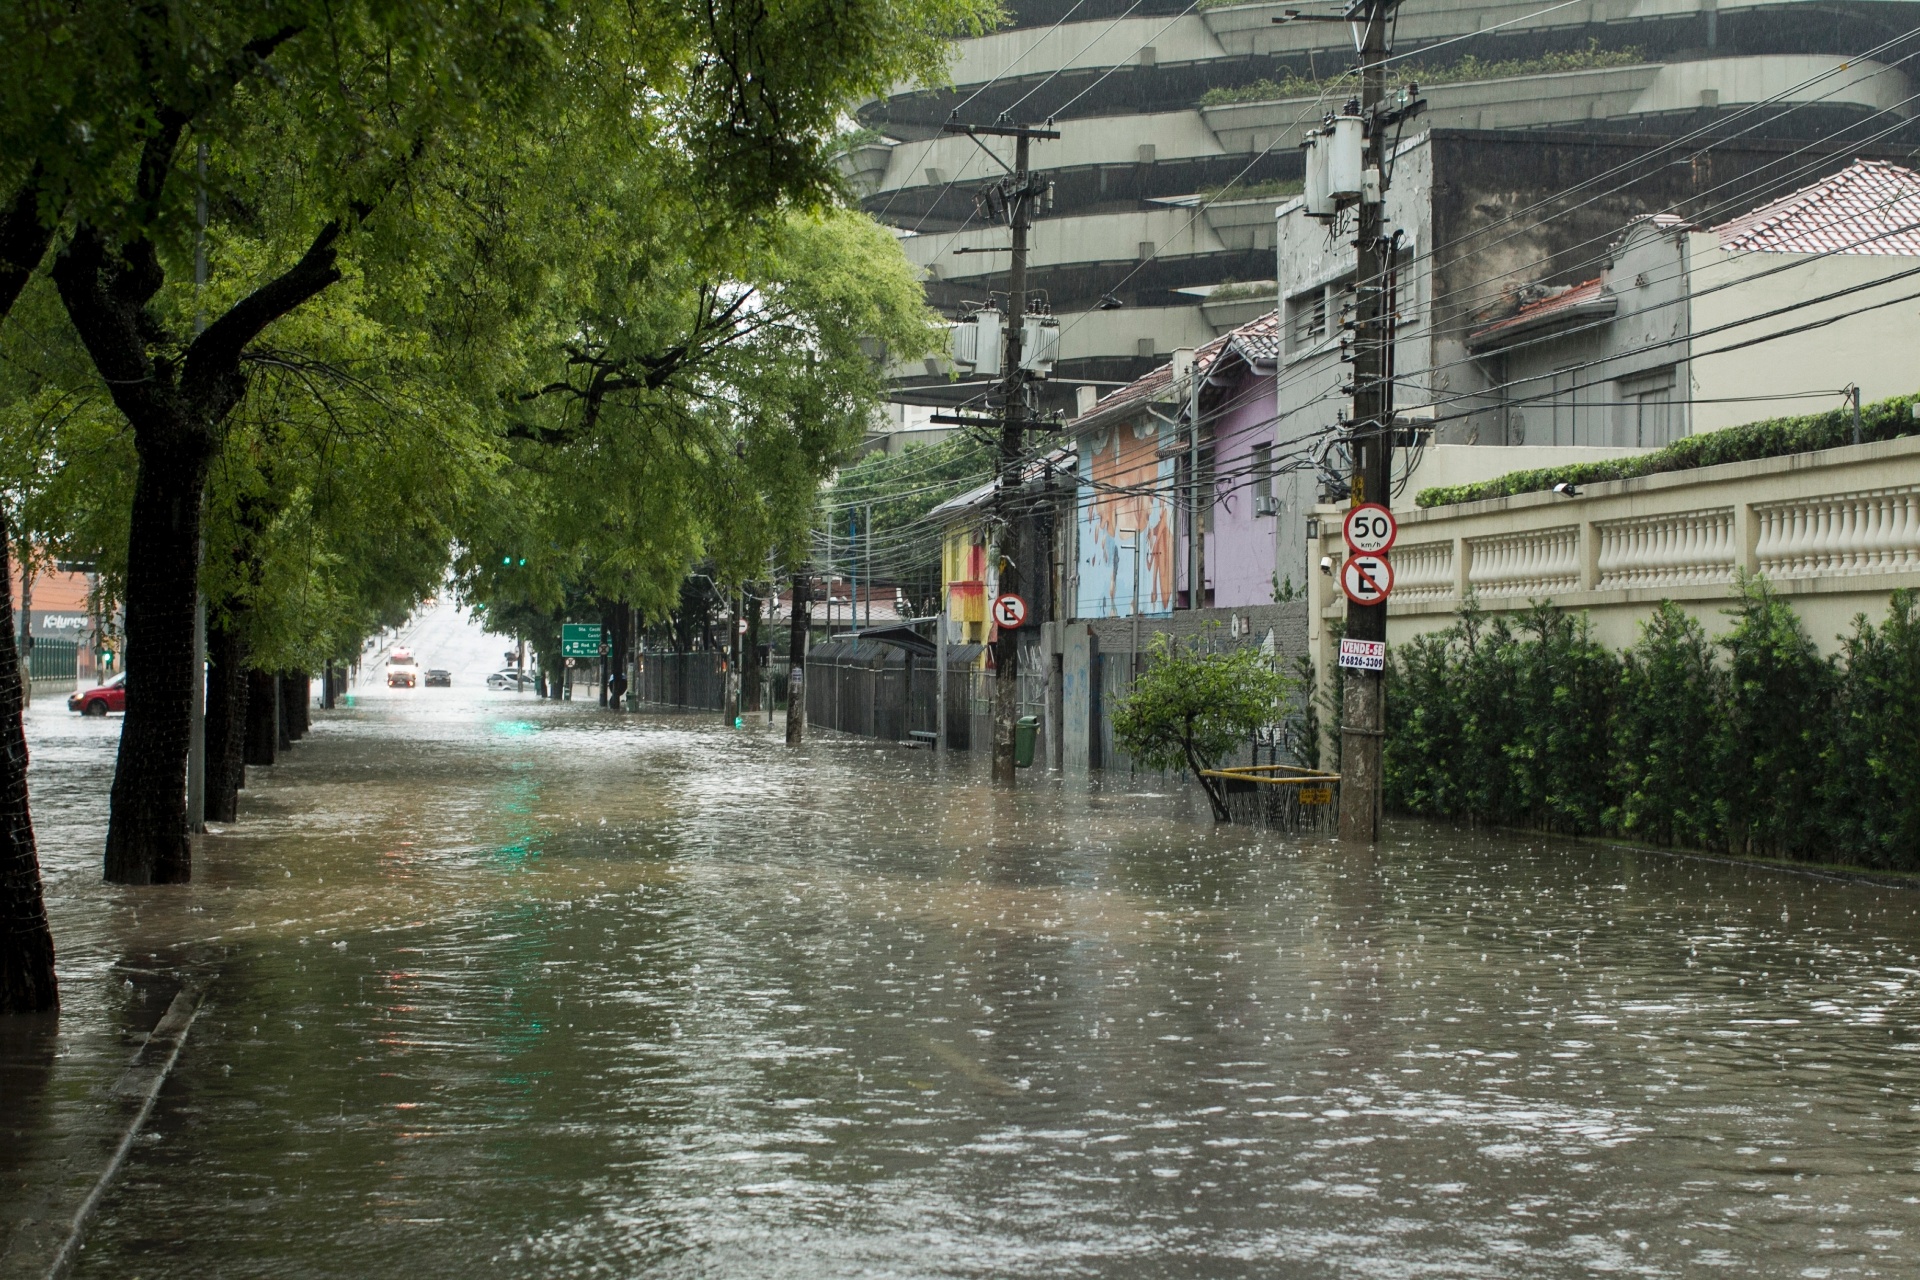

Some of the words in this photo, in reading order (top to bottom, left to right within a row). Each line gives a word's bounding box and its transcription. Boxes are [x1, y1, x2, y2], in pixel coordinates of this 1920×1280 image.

[1354, 516, 1388, 538] 50
[1360, 541, 1381, 549] km/h
[1358, 562, 1377, 593] E
[1003, 601, 1017, 621] E
[42, 614, 88, 629] Kalunga
[1342, 641, 1383, 656] VENDE-SE
